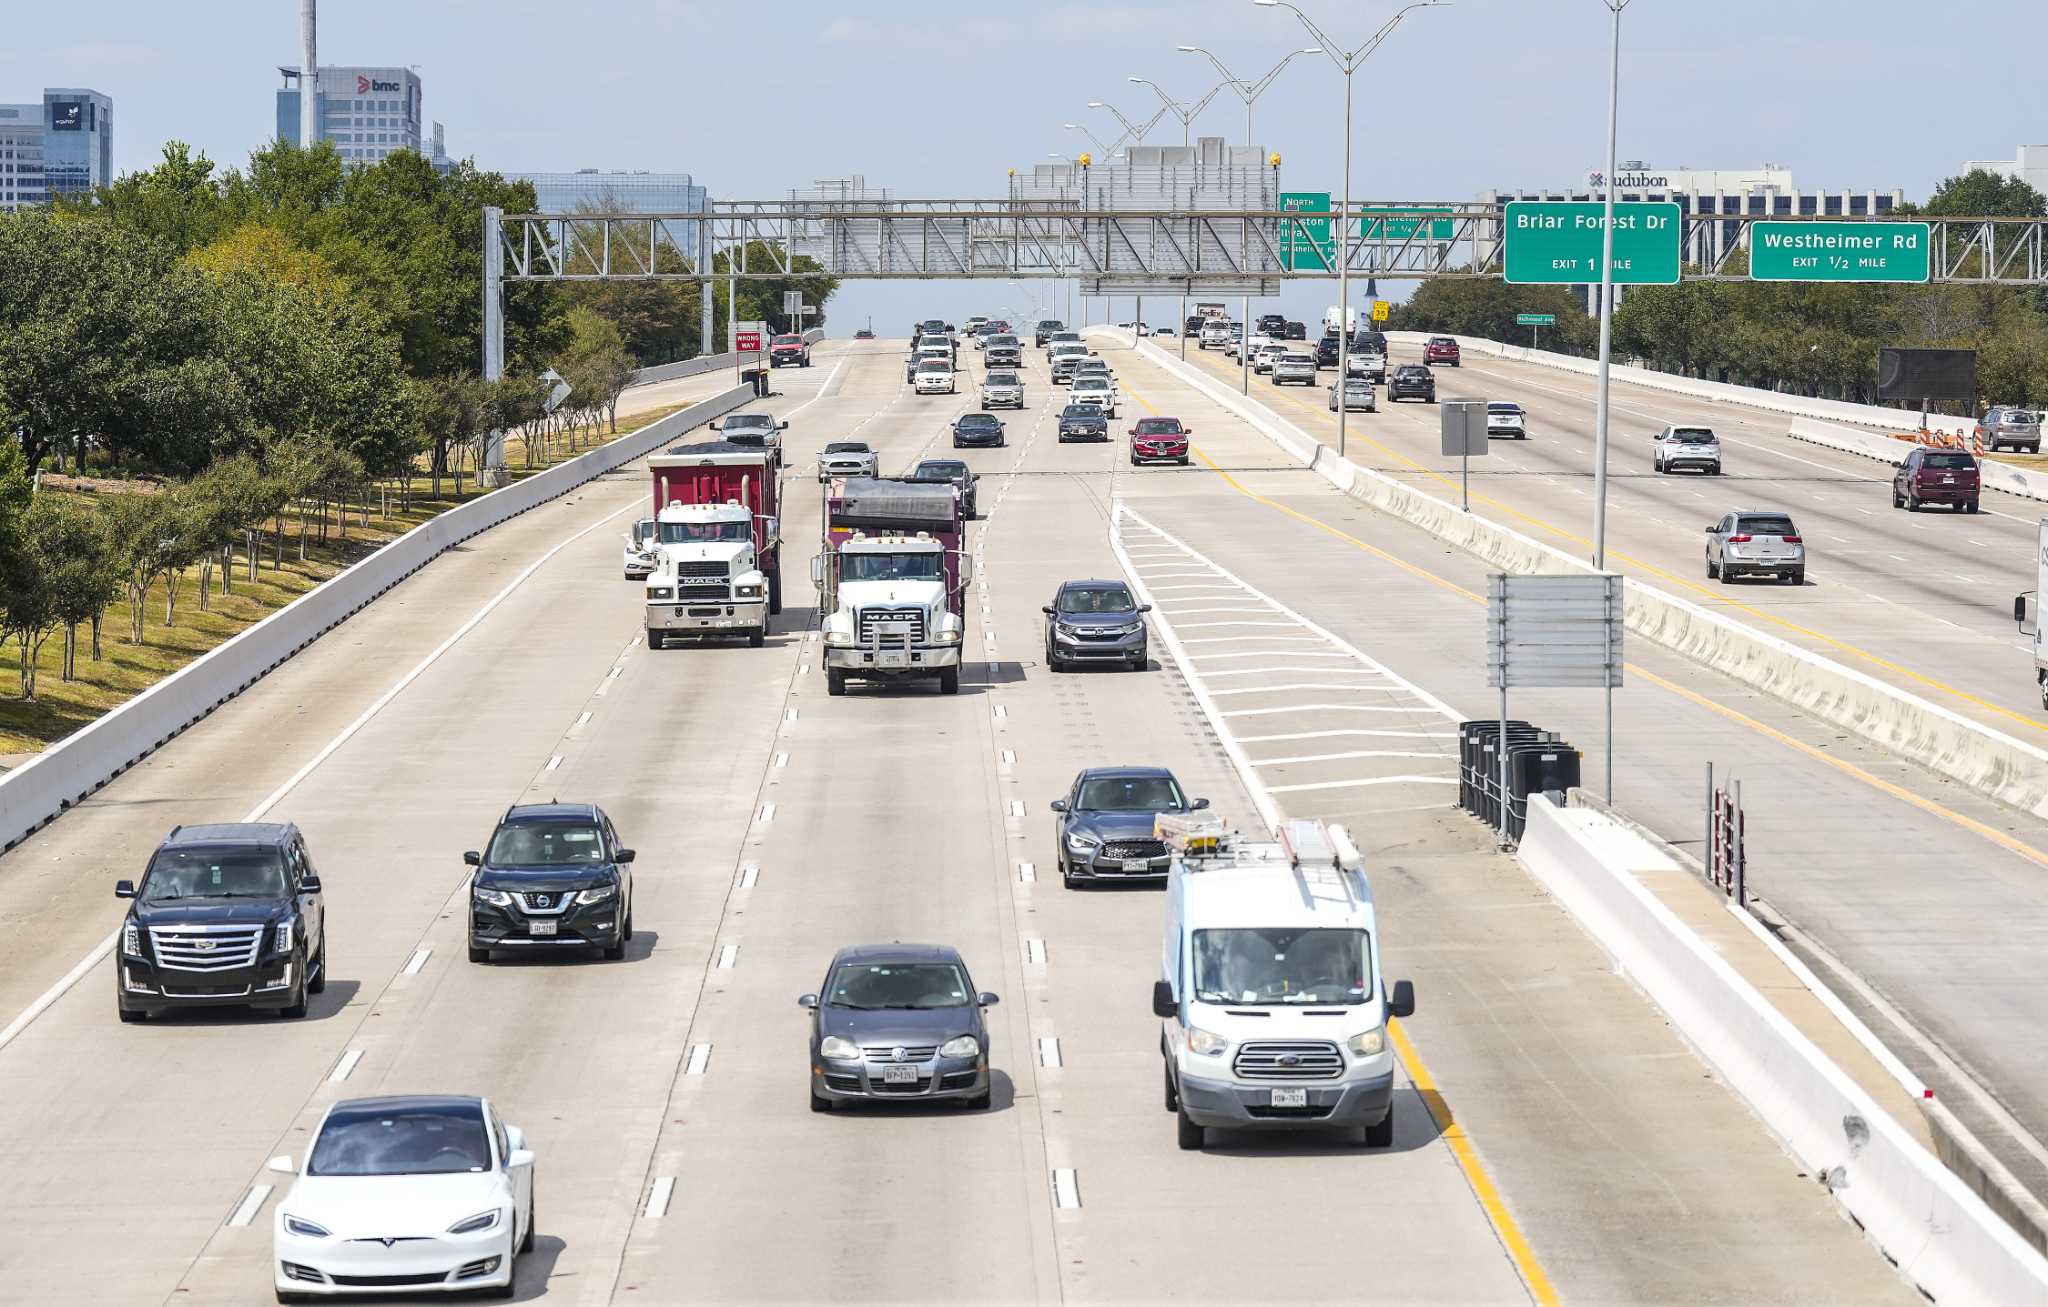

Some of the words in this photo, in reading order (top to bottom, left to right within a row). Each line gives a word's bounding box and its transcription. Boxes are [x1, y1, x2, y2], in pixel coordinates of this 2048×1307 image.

[371, 79, 400, 91] bmc
[1281, 217, 1324, 226] Hston
[1517, 214, 1564, 229] Briar
[1575, 215, 1636, 229] Forest
[1647, 215, 1667, 229] Dr
[1765, 234, 1882, 248] Westheimer
[1893, 234, 1917, 248] Rd
[1552, 260, 1577, 269] EXIT
[1588, 258, 1595, 271] 1
[1611, 260, 1631, 269] ILE
[1793, 257, 1818, 267] EXIT
[1829, 256, 1848, 269] 1/2
[1859, 258, 1886, 267] MILE
